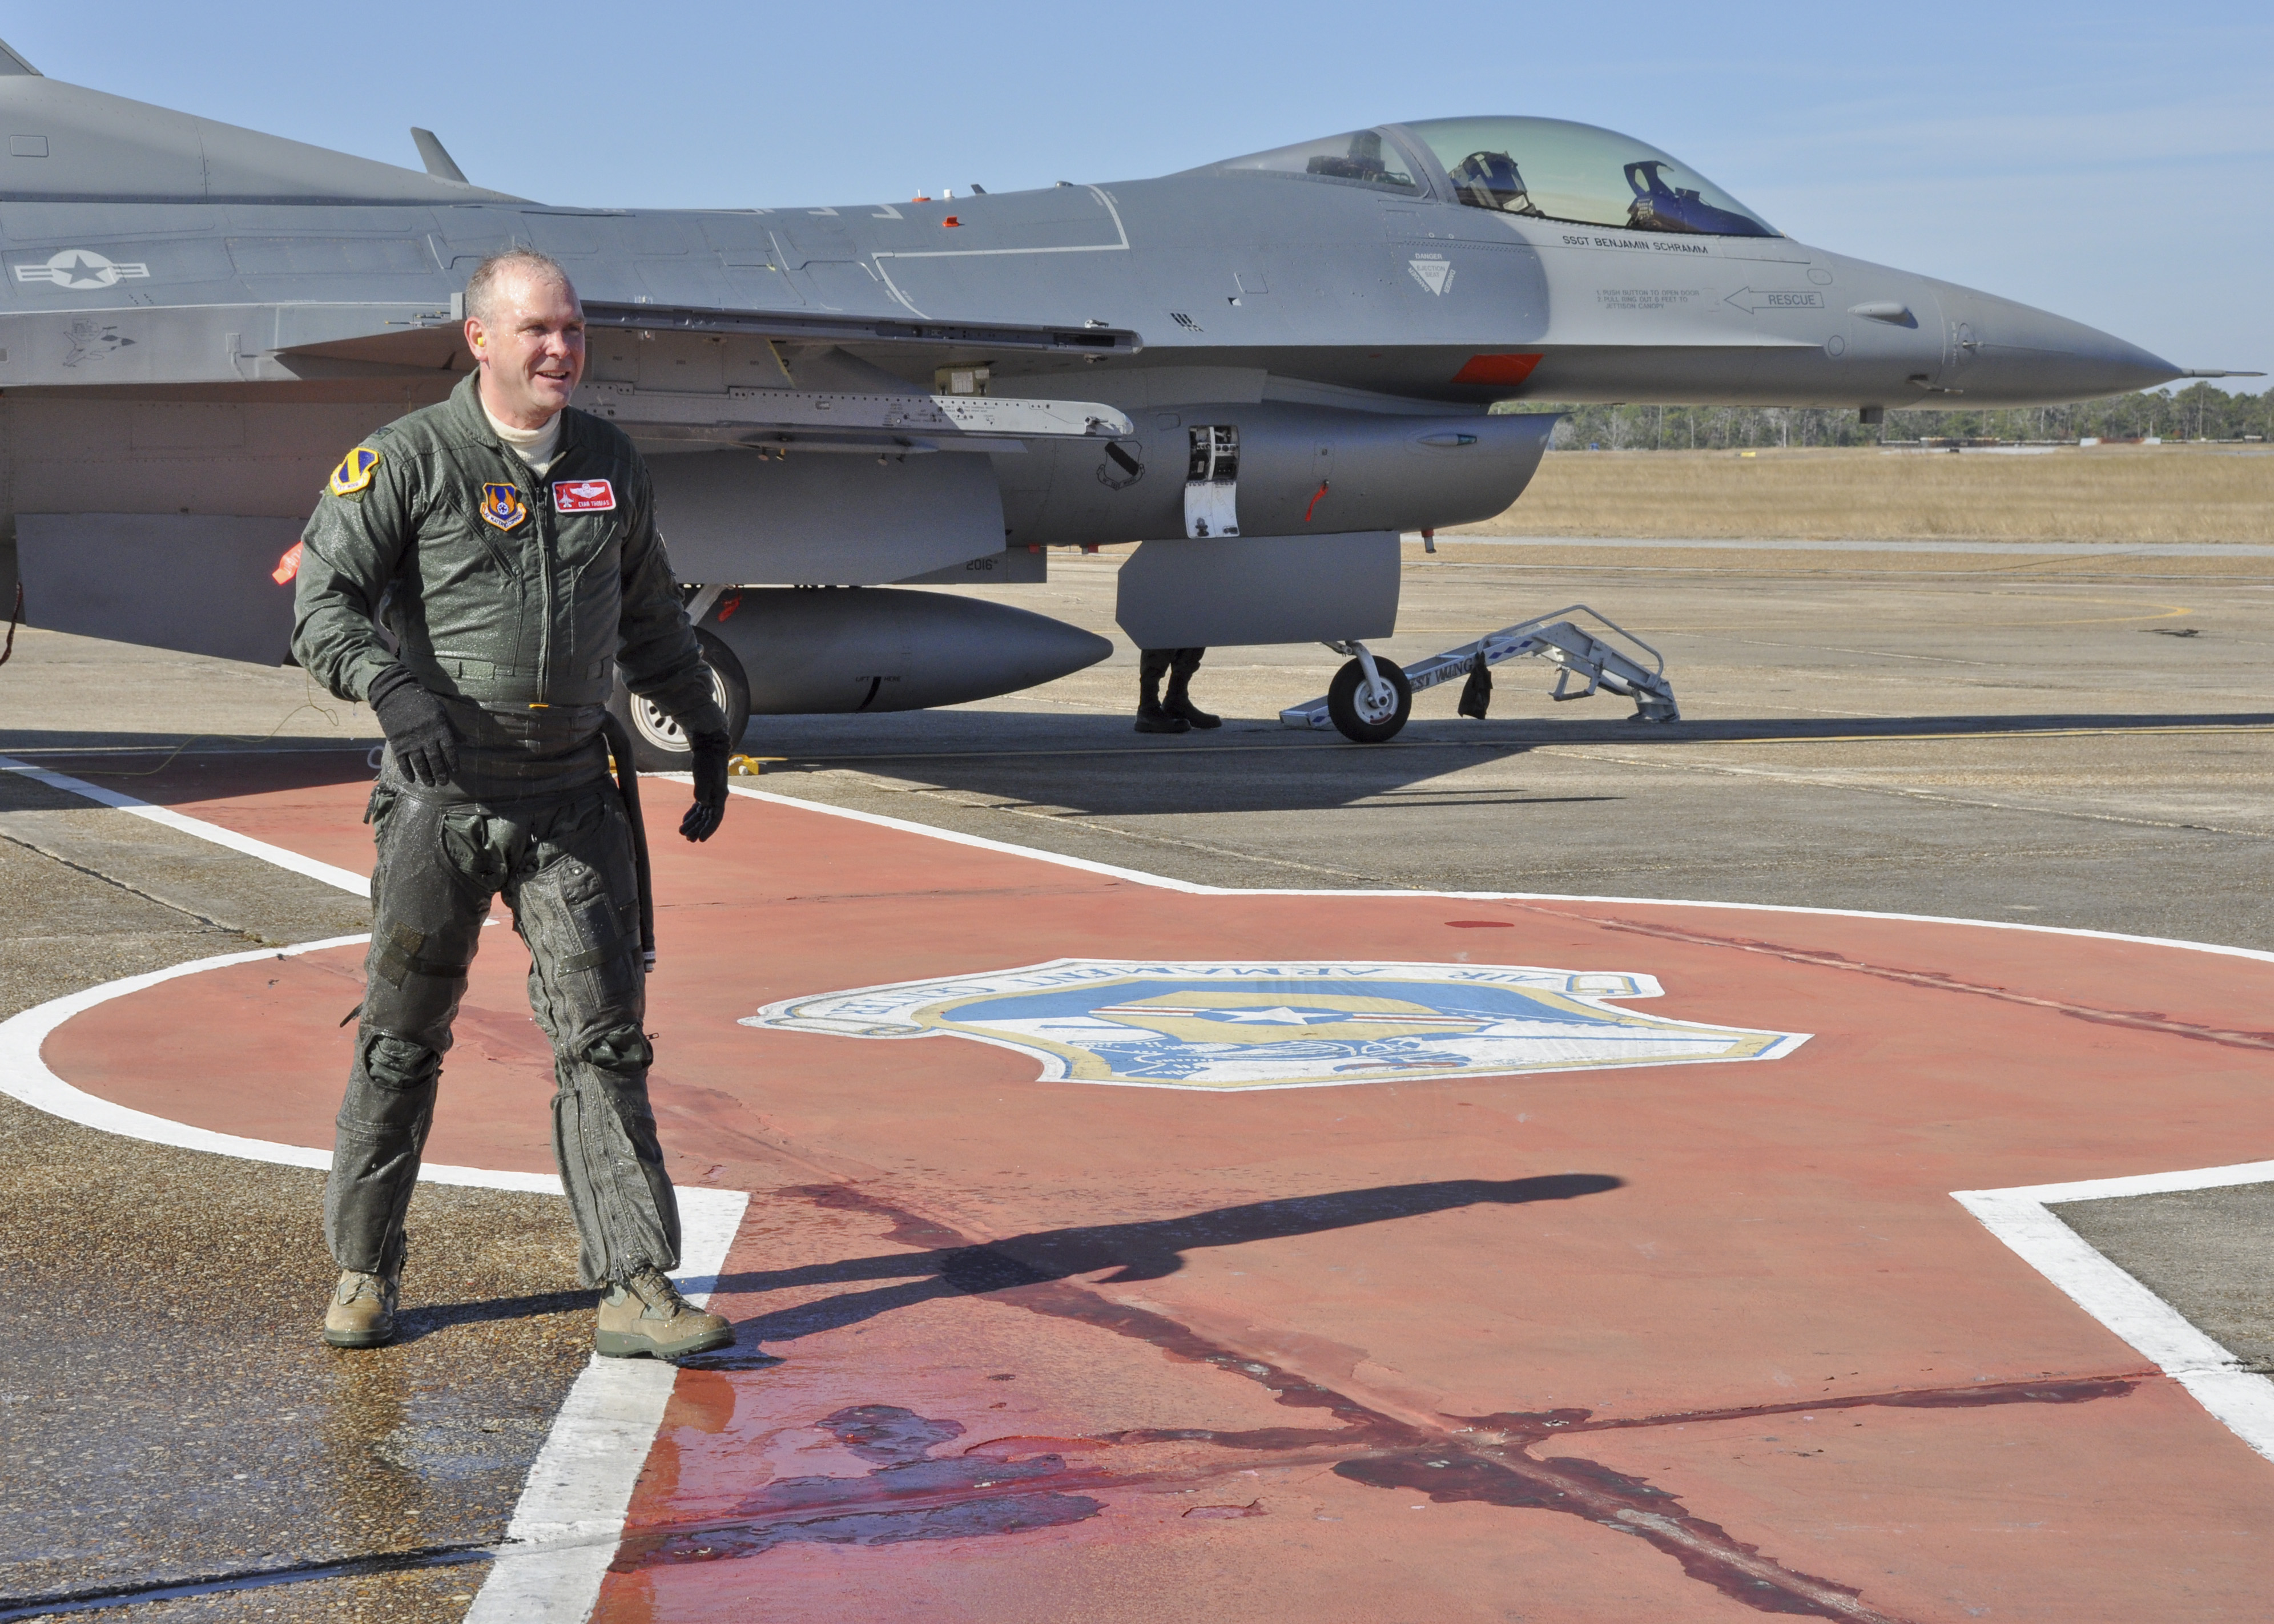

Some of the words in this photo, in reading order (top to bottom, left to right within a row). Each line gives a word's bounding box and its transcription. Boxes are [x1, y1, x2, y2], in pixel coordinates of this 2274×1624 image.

[1563, 236, 1590, 245] SSGT
[1595, 237, 1649, 250] BENJAMIN
[1653, 242, 1708, 254] SCHRAMM
[1408, 267, 1431, 292] DANGER
[1768, 294, 1816, 305] RESCUE
[967, 559, 993, 570] 2016
[1435, 658, 1473, 683] WING
[1006, 967, 1393, 988] ARMAMENT
[1448, 971, 1560, 982] AIR
[824, 986, 997, 1015] CENTER
